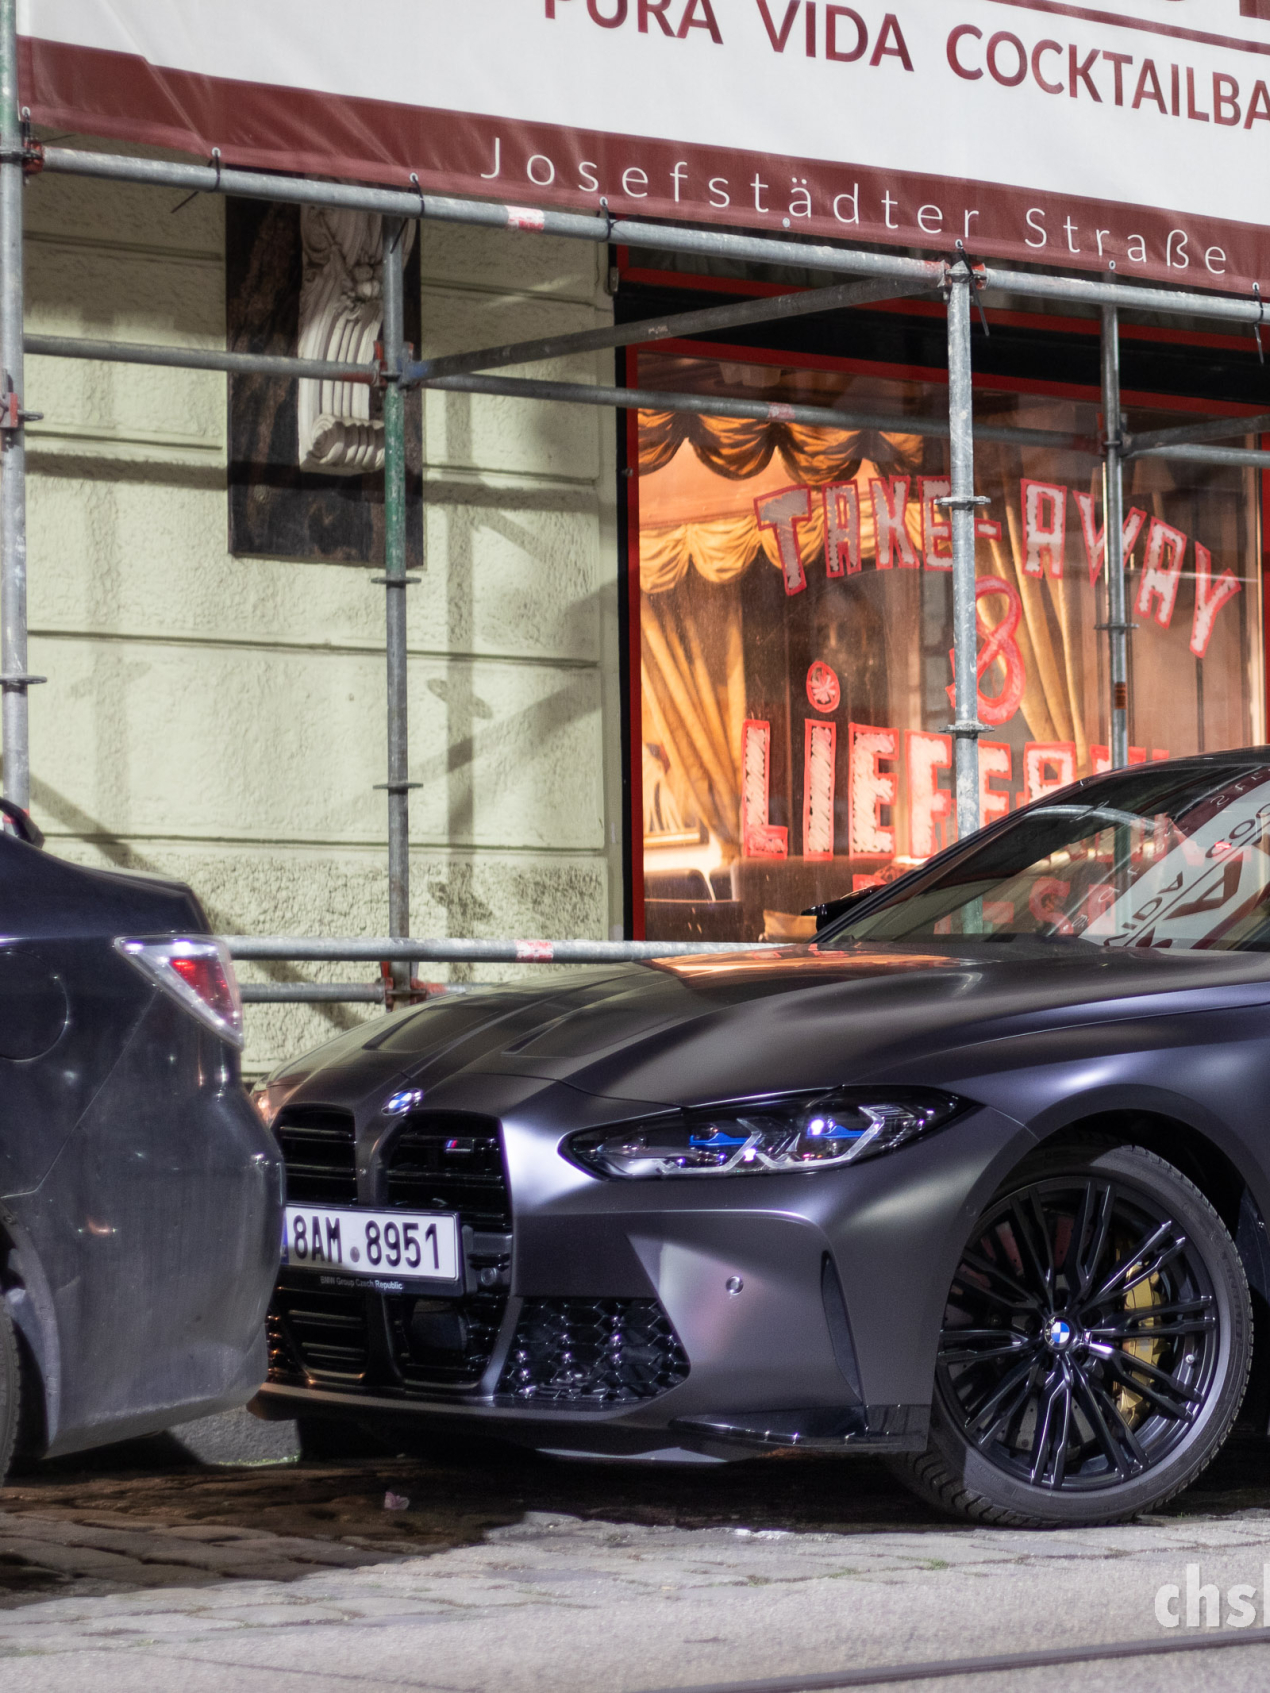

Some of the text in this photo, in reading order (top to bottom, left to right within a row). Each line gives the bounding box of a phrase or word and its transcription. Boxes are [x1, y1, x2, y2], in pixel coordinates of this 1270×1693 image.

[756, 0, 914, 72] VIDA
[481, 138, 980, 238] Josefstädter
[1024, 207, 1227, 274] Straße
[292, 1214, 441, 1270] 8AM 8951
[374, 1280, 404, 1290] Republic
